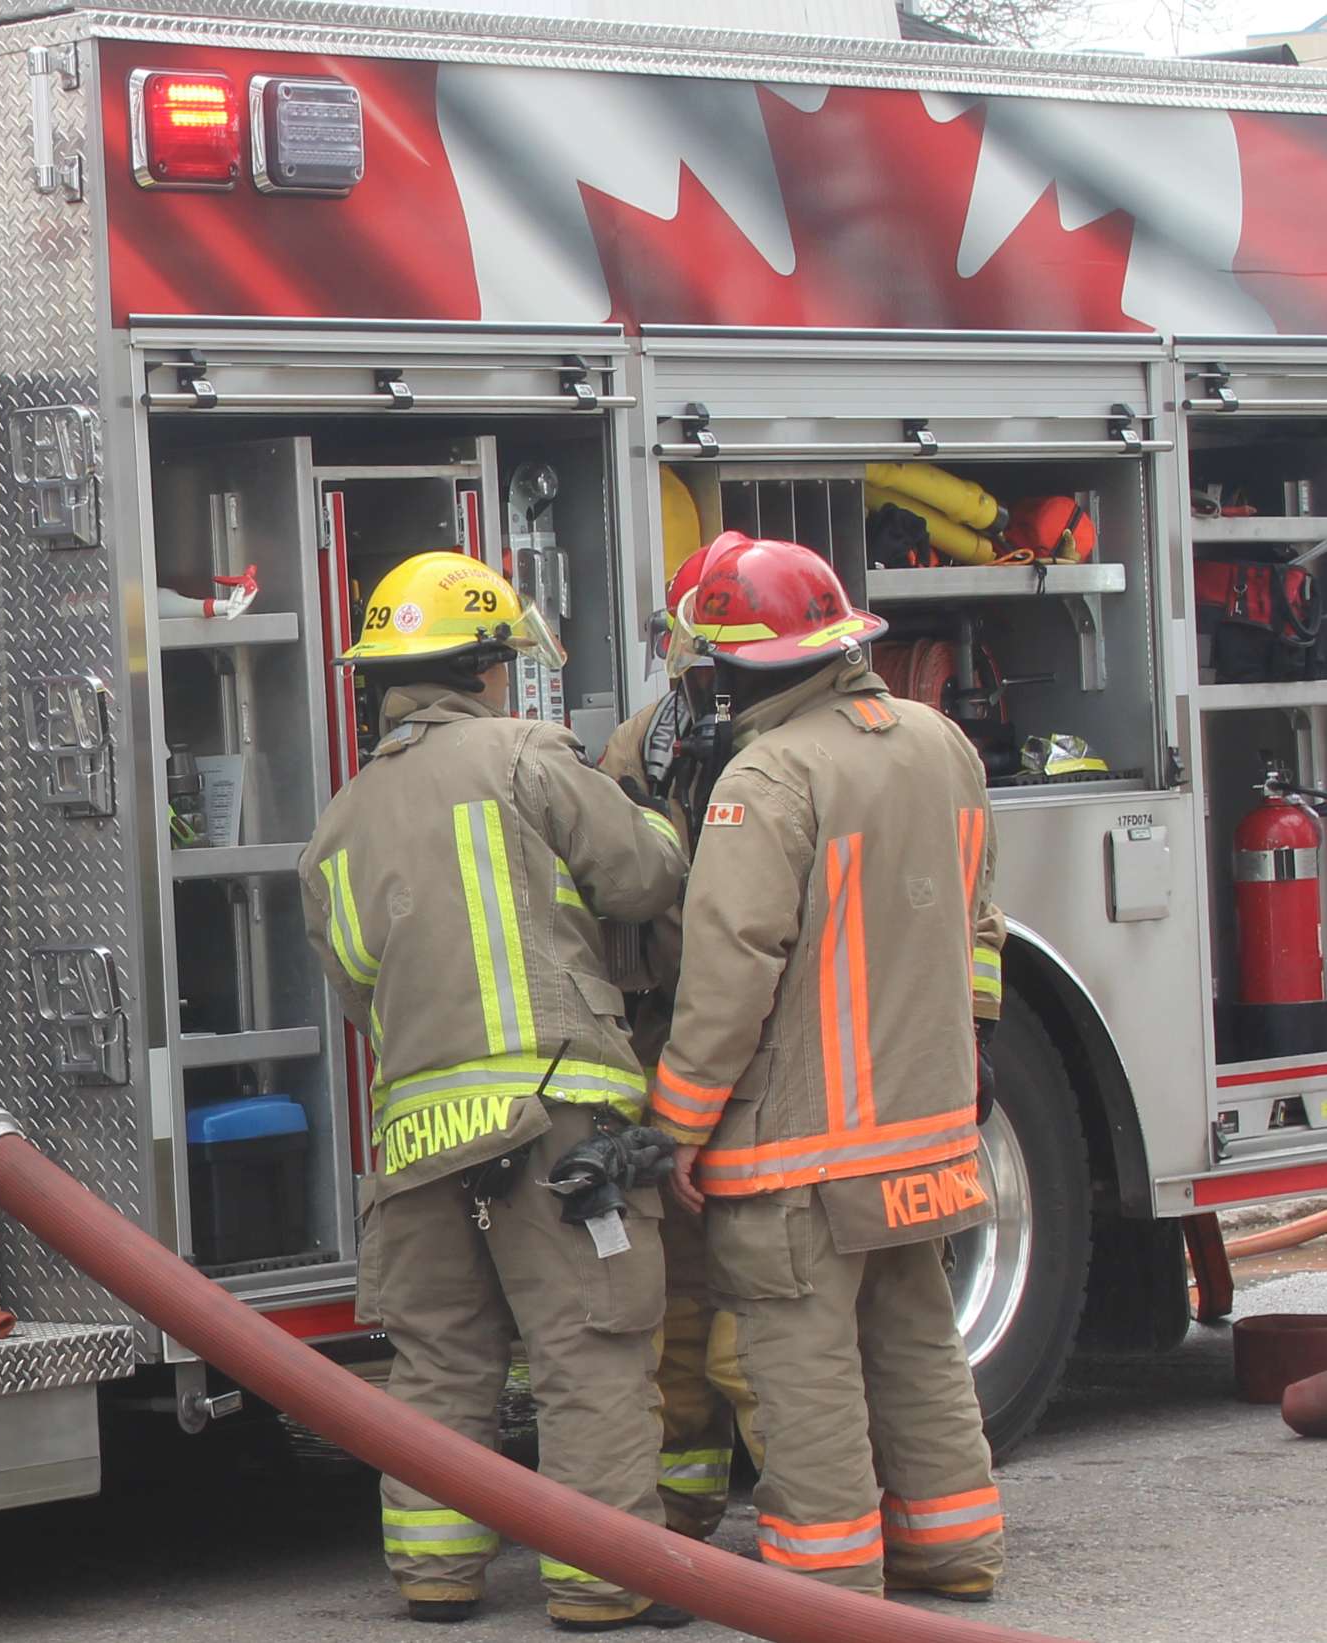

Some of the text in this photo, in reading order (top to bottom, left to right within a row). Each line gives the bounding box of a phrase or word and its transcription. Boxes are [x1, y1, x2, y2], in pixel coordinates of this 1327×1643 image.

[464, 589, 497, 613] 29
[805, 592, 838, 623] 42
[366, 606, 391, 629] 29
[1117, 813, 1153, 826] 17FD074
